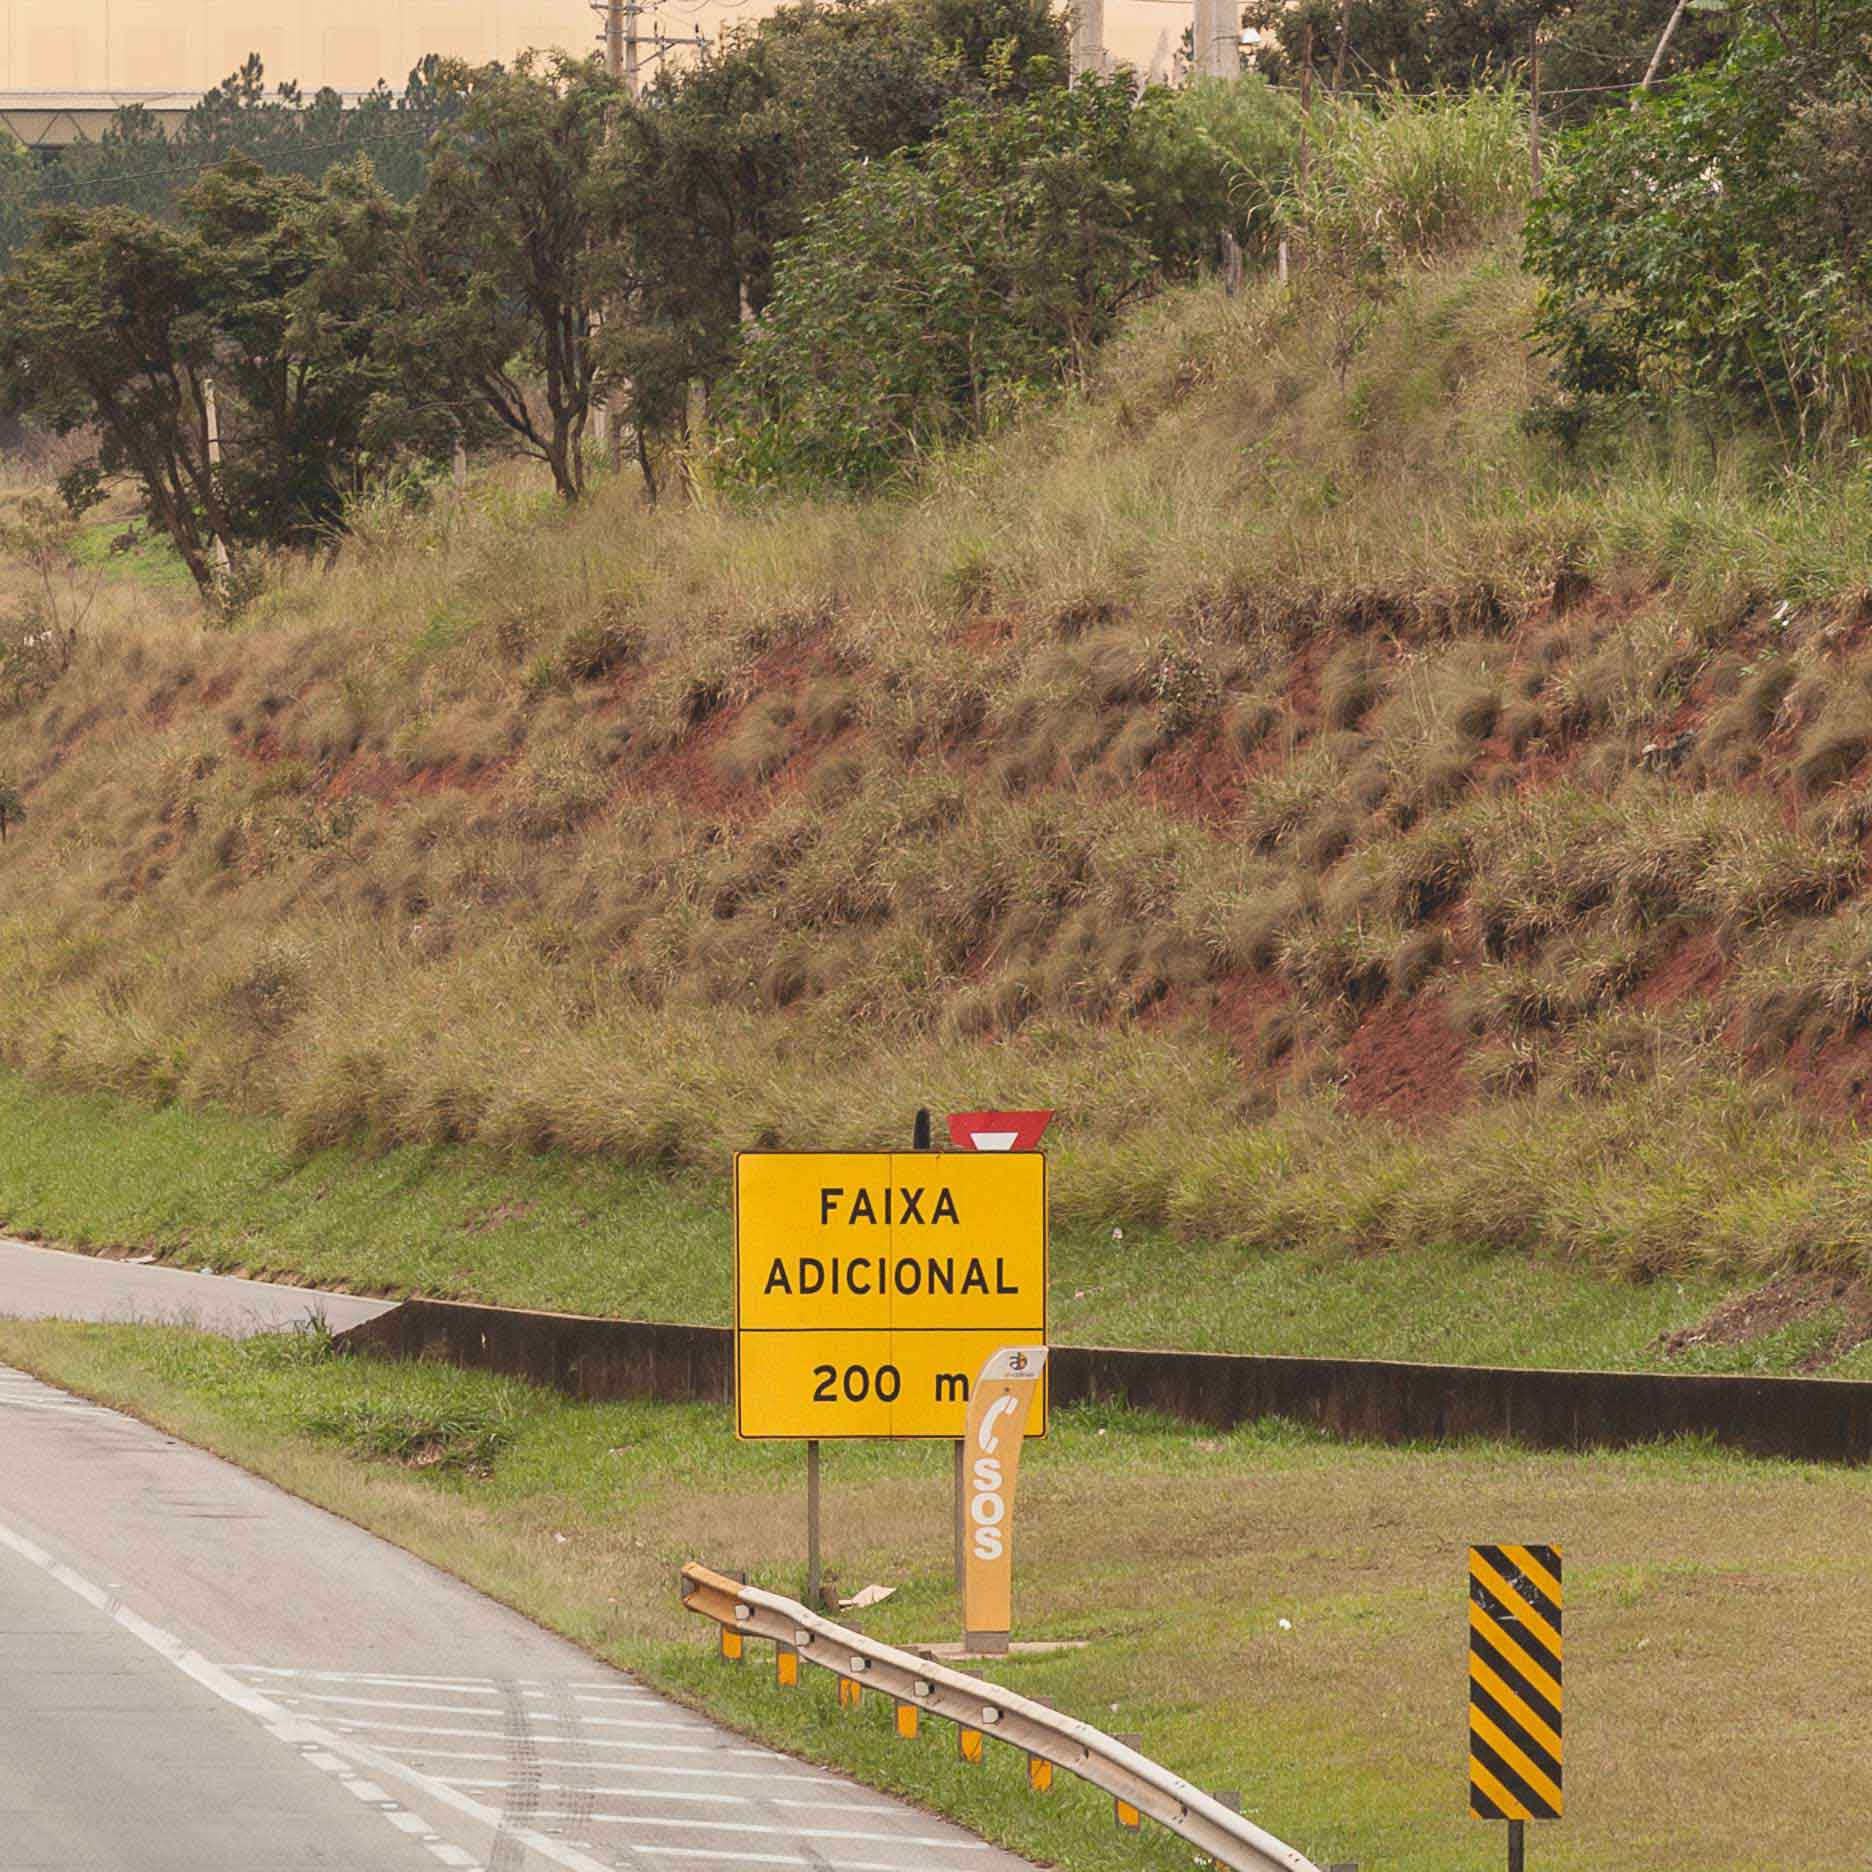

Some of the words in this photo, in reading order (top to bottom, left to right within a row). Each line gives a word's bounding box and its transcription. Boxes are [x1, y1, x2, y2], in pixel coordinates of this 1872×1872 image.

[820, 1187, 960, 1225] FAIXA
[763, 1257, 1019, 1296] ADICIONAL
[812, 1364, 902, 1403] 200
[934, 1372, 970, 1402] m
[970, 1456, 1005, 1561] SOS
